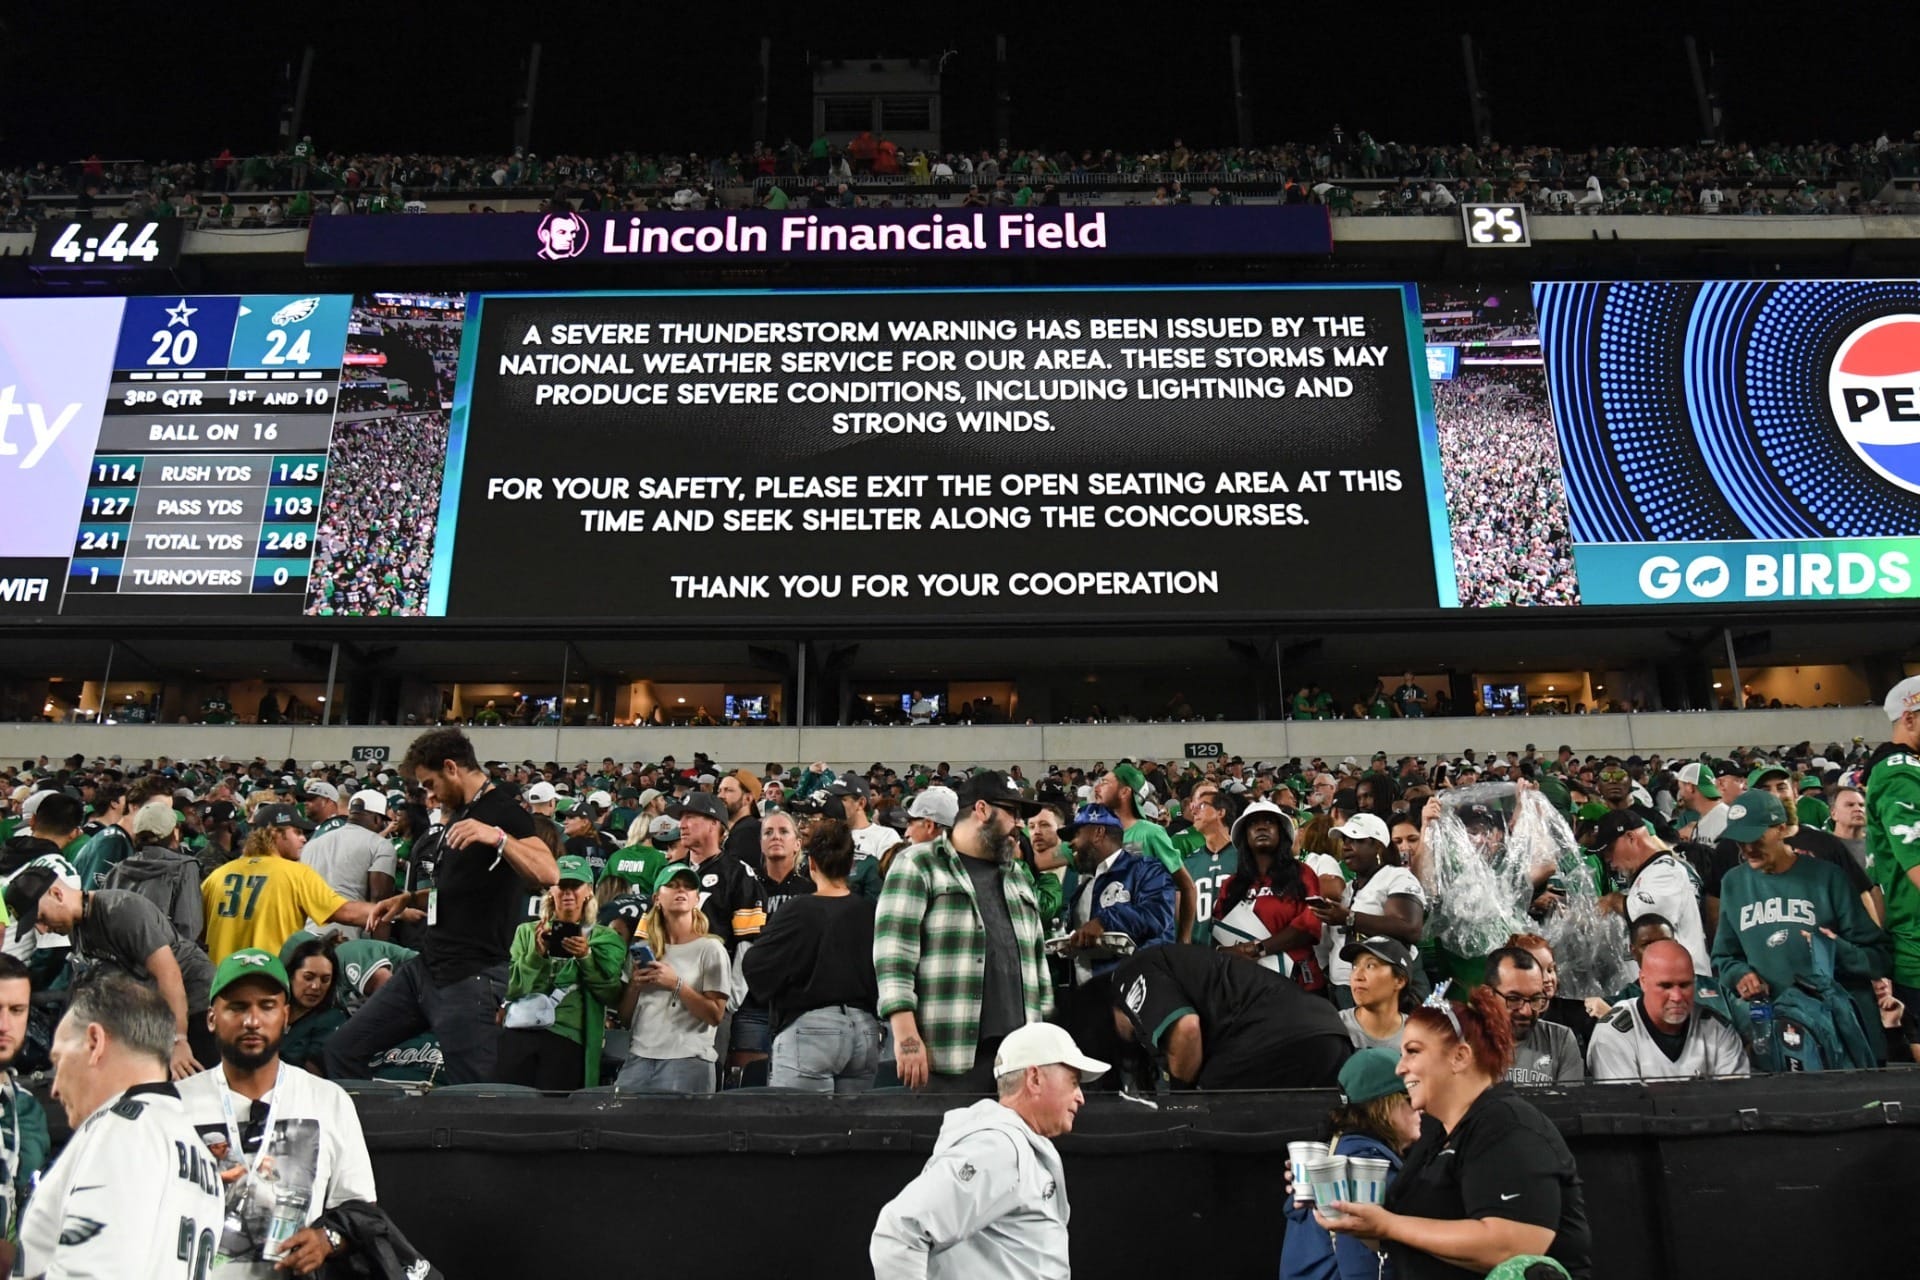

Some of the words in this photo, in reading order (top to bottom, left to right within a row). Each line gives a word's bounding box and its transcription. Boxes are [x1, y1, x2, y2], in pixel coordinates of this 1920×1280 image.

[603, 216, 767, 253] Lincoln
[782, 213, 987, 251] Financial
[999, 212, 1106, 249] Field
[1472, 208, 1522, 243] 25
[50, 222, 159, 263] 4:44
[522, 324, 542, 345] A
[550, 323, 651, 345] SEVERE
[658, 321, 879, 344] THUNDERSTORM
[887, 319, 1017, 341] WARNING
[1026, 319, 1082, 340] HAS
[1090, 318, 1158, 339] BEEN
[1167, 317, 1263, 339] ISSUED
[1271, 317, 1305, 338] BY
[1312, 316, 1366, 337] THE
[146, 329, 198, 365] 20
[261, 329, 311, 365] 24
[499, 353, 634, 375] NATIONAL
[642, 352, 772, 374] WEATHER
[781, 351, 893, 373] SERVICE
[902, 350, 957, 372] FOR
[965, 349, 1026, 371] OUR
[1033, 348, 1113, 370] AREA.
[1120, 348, 1207, 369] THESE
[1214, 346, 1325, 368] STORMS
[1333, 346, 1388, 367] MAY
[124, 389, 157, 406] 3RD
[162, 389, 204, 408] QTR
[228, 388, 257, 405] 1ST
[263, 391, 299, 405] AND
[305, 387, 329, 405] 10
[535, 383, 669, 405] PRODUCE
[677, 382, 779, 404] SEVERE
[787, 380, 967, 404] CONDITIONS,
[976, 378, 1128, 401] INCLUDING
[1137, 377, 1286, 400] LIGHTNING
[1294, 376, 1353, 398] AND
[832, 411, 948, 434] STRONG
[955, 410, 1056, 433] WINDS.
[149, 424, 200, 441] BALL
[206, 424, 239, 441] ON
[254, 423, 278, 441] 16
[98, 463, 136, 482] 114
[161, 465, 211, 482] RUSH
[215, 465, 252, 482] YDS
[279, 463, 319, 481] 145
[487, 477, 543, 500] FOR
[552, 477, 630, 499] YOUR
[638, 477, 745, 501] SAFETY,
[755, 476, 858, 498] PLEASE
[867, 475, 929, 498] EXIT
[937, 474, 992, 497] THE
[1000, 473, 1079, 496] OPEN
[1088, 472, 1206, 495] SEATING
[1215, 471, 1289, 494] AREA
[1297, 470, 1331, 493] AT
[1339, 469, 1402, 492] THIS
[91, 497, 131, 515] 127
[157, 499, 202, 515] PASS
[206, 499, 243, 515] YDS
[274, 496, 313, 515] 103
[580, 510, 645, 532] TIME
[652, 509, 714, 532] AND
[723, 509, 794, 532] SEEK
[802, 508, 922, 531] SHELTER
[930, 506, 1031, 530] ALONG
[1040, 505, 1096, 528] THE
[1104, 503, 1309, 528] CONCOURSES.
[80, 531, 120, 550] 241
[145, 534, 201, 550] TOTAL
[206, 534, 244, 550] YDS
[265, 531, 308, 550] 248
[90, 566, 99, 585] 1
[133, 569, 243, 586] TURNOVERS
[273, 567, 289, 586] 0
[670, 575, 770, 598] THANK
[779, 575, 841, 598] YOU
[852, 574, 909, 598] FOR
[917, 573, 1000, 597] YOUR
[1008, 570, 1218, 596] COOPERATION
[1638, 554, 1731, 600] GO
[1744, 549, 1912, 598] BIRDS
[357, 748, 385, 760] 130
[1189, 744, 1219, 757] 129
[617, 859, 644, 872] BROWN
[218, 872, 268, 920] 37
[1740, 898, 1816, 931] EAGLES
